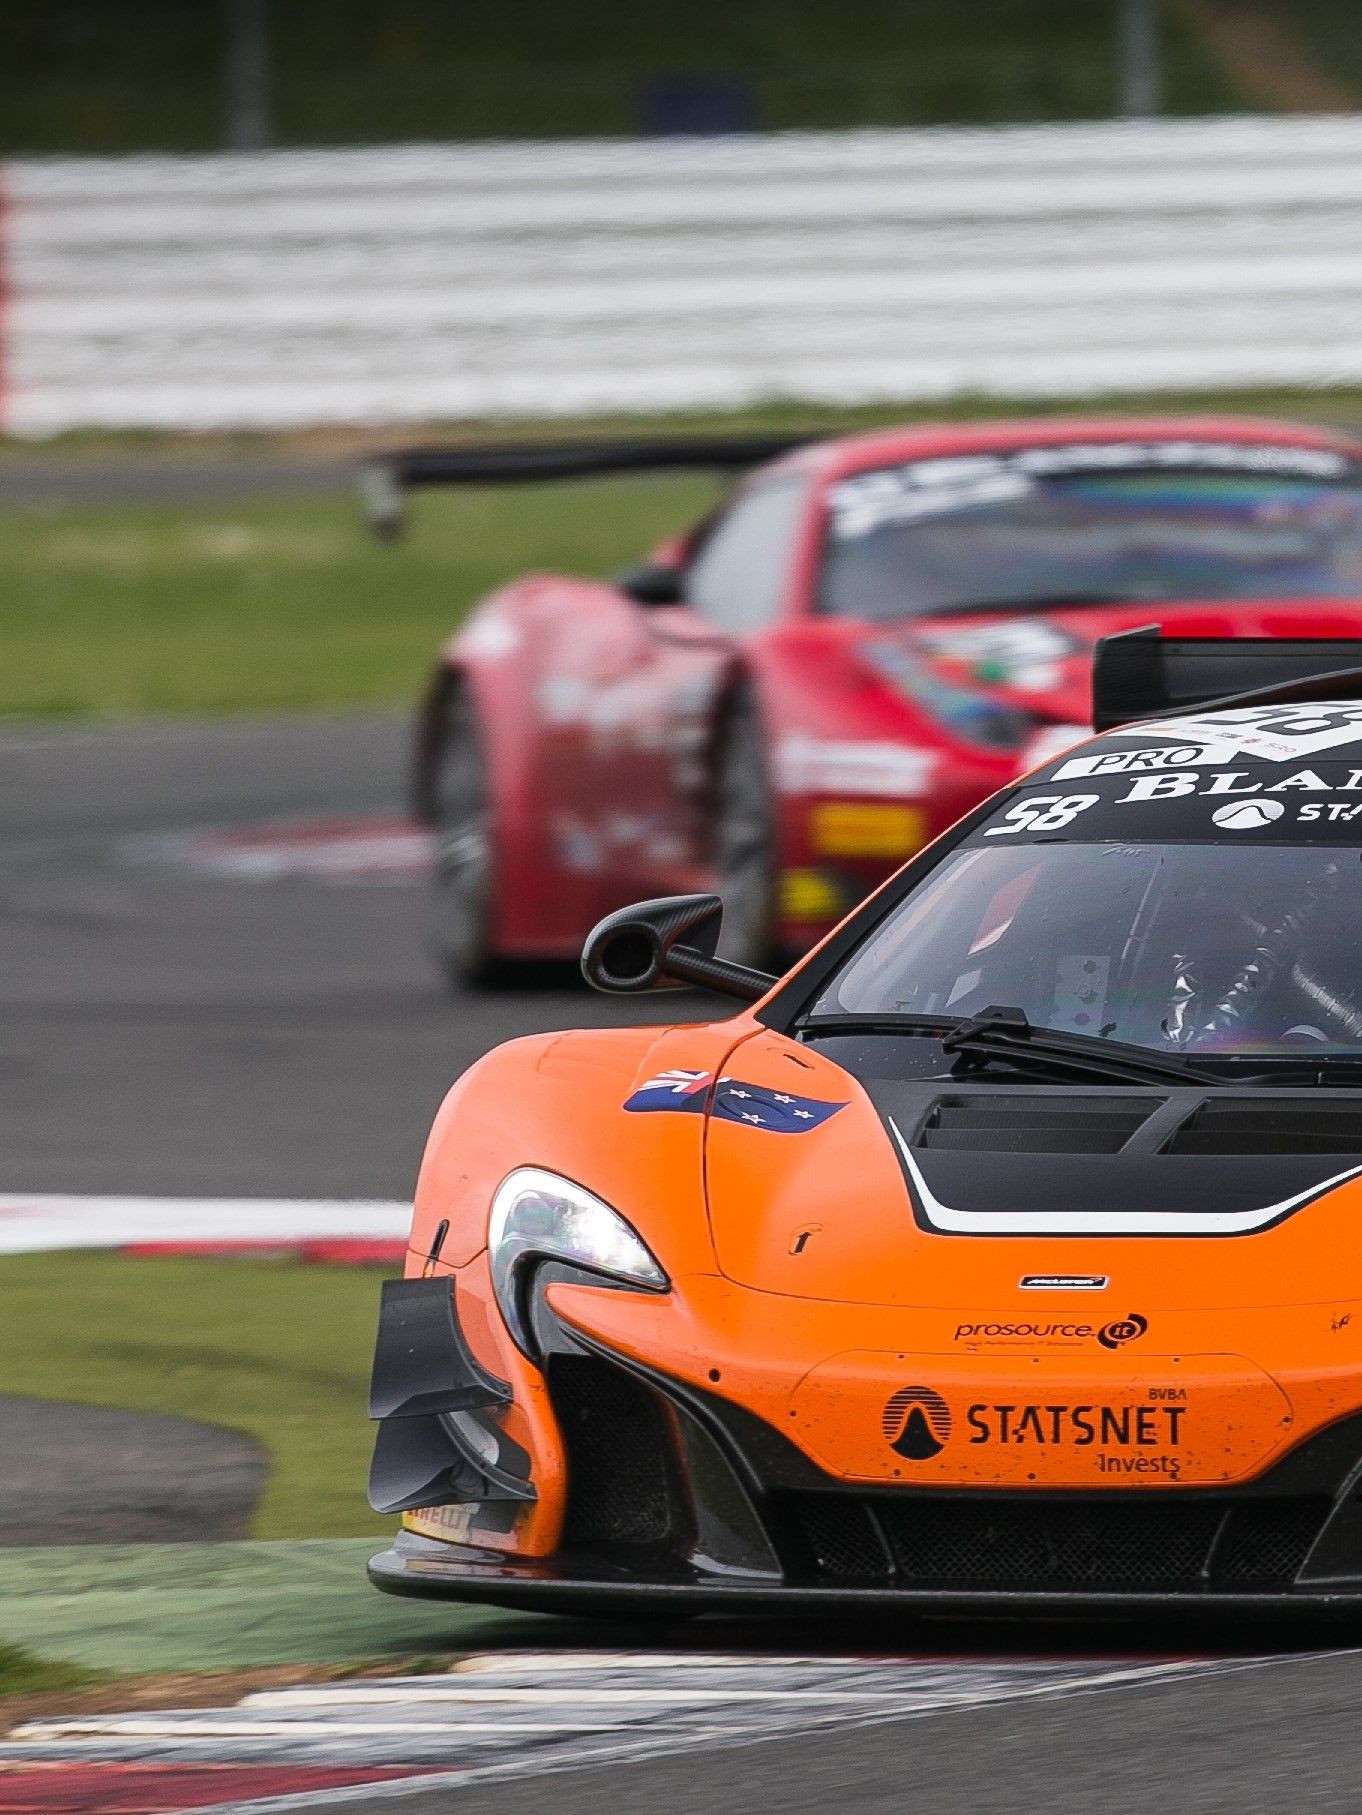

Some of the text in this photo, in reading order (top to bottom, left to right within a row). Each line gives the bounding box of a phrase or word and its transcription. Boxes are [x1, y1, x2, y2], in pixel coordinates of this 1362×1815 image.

[1088, 747, 1204, 774] PRO
[984, 793, 1100, 837] 58
[1148, 1388, 1188, 1400] BVBA
[967, 1404, 1187, 1446] STATSNET
[1098, 1453, 1181, 1474] Invests
[408, 1504, 460, 1529] IRELLI
